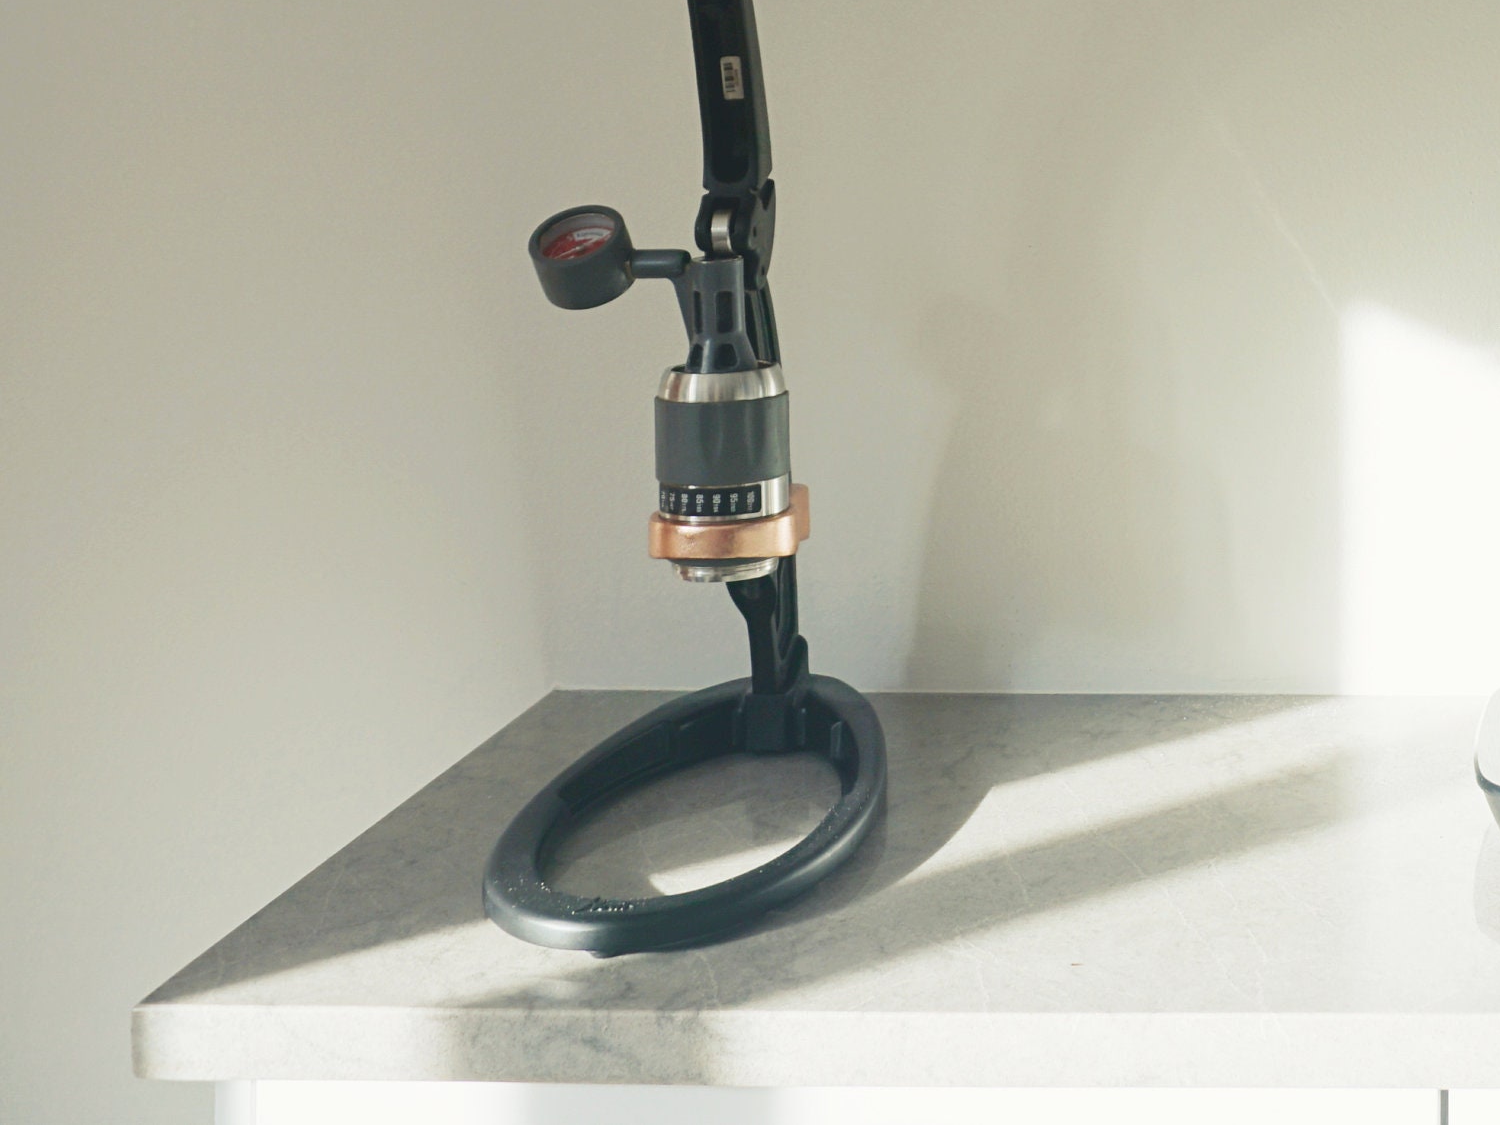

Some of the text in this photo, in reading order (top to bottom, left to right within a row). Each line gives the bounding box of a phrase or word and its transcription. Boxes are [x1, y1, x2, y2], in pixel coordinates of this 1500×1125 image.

[681, 493, 688, 503] 80
[696, 494, 704, 504] 85
[713, 494, 721, 504] 90
[730, 493, 738, 503] 95
